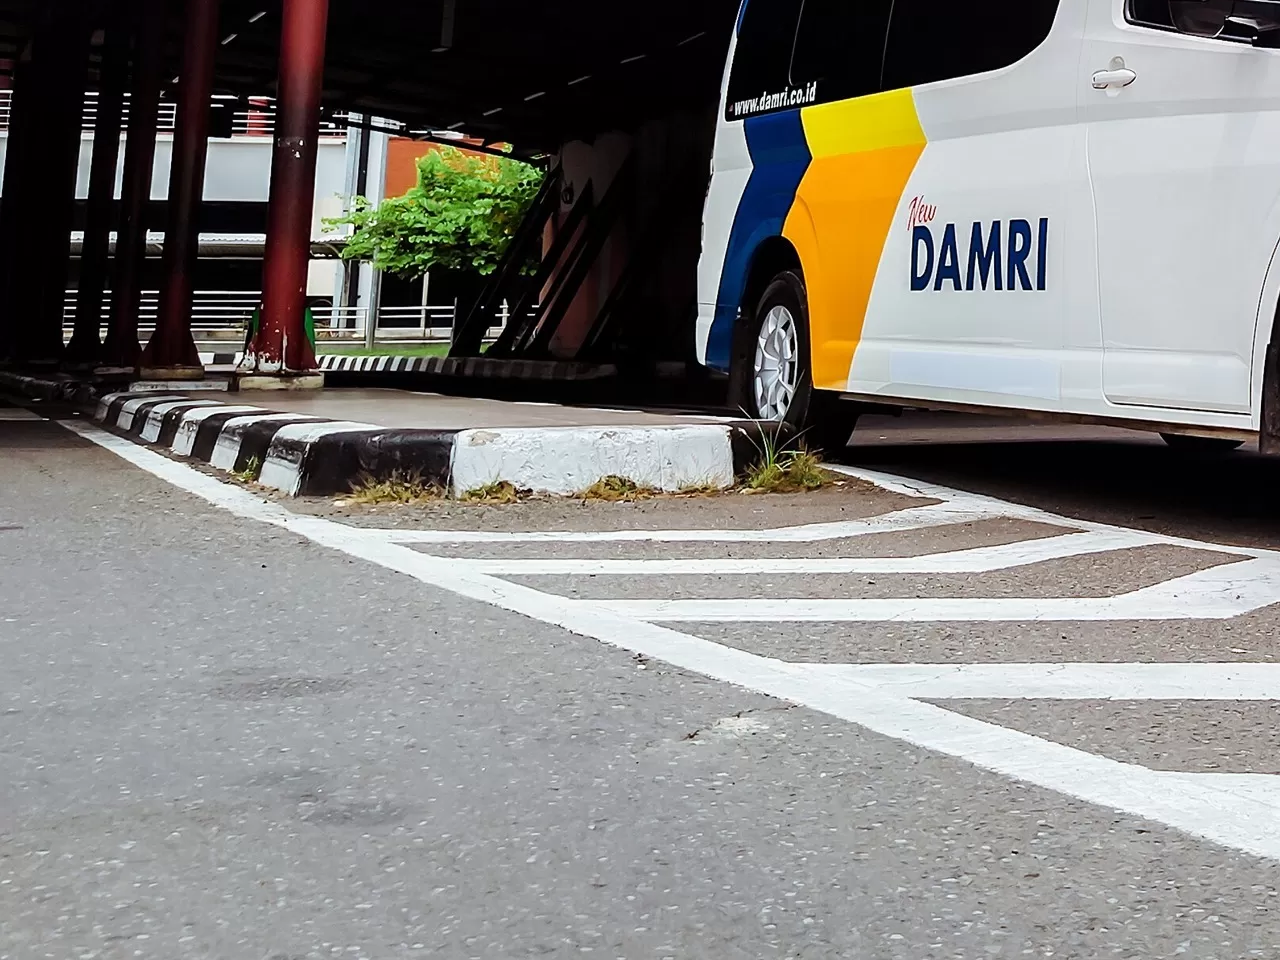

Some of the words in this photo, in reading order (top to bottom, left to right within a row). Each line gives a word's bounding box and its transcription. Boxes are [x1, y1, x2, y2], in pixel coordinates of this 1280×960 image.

[734, 81, 817, 116] www.damri.co.id
[907, 194, 937, 231] New
[910, 217, 1049, 291] DAMRI
